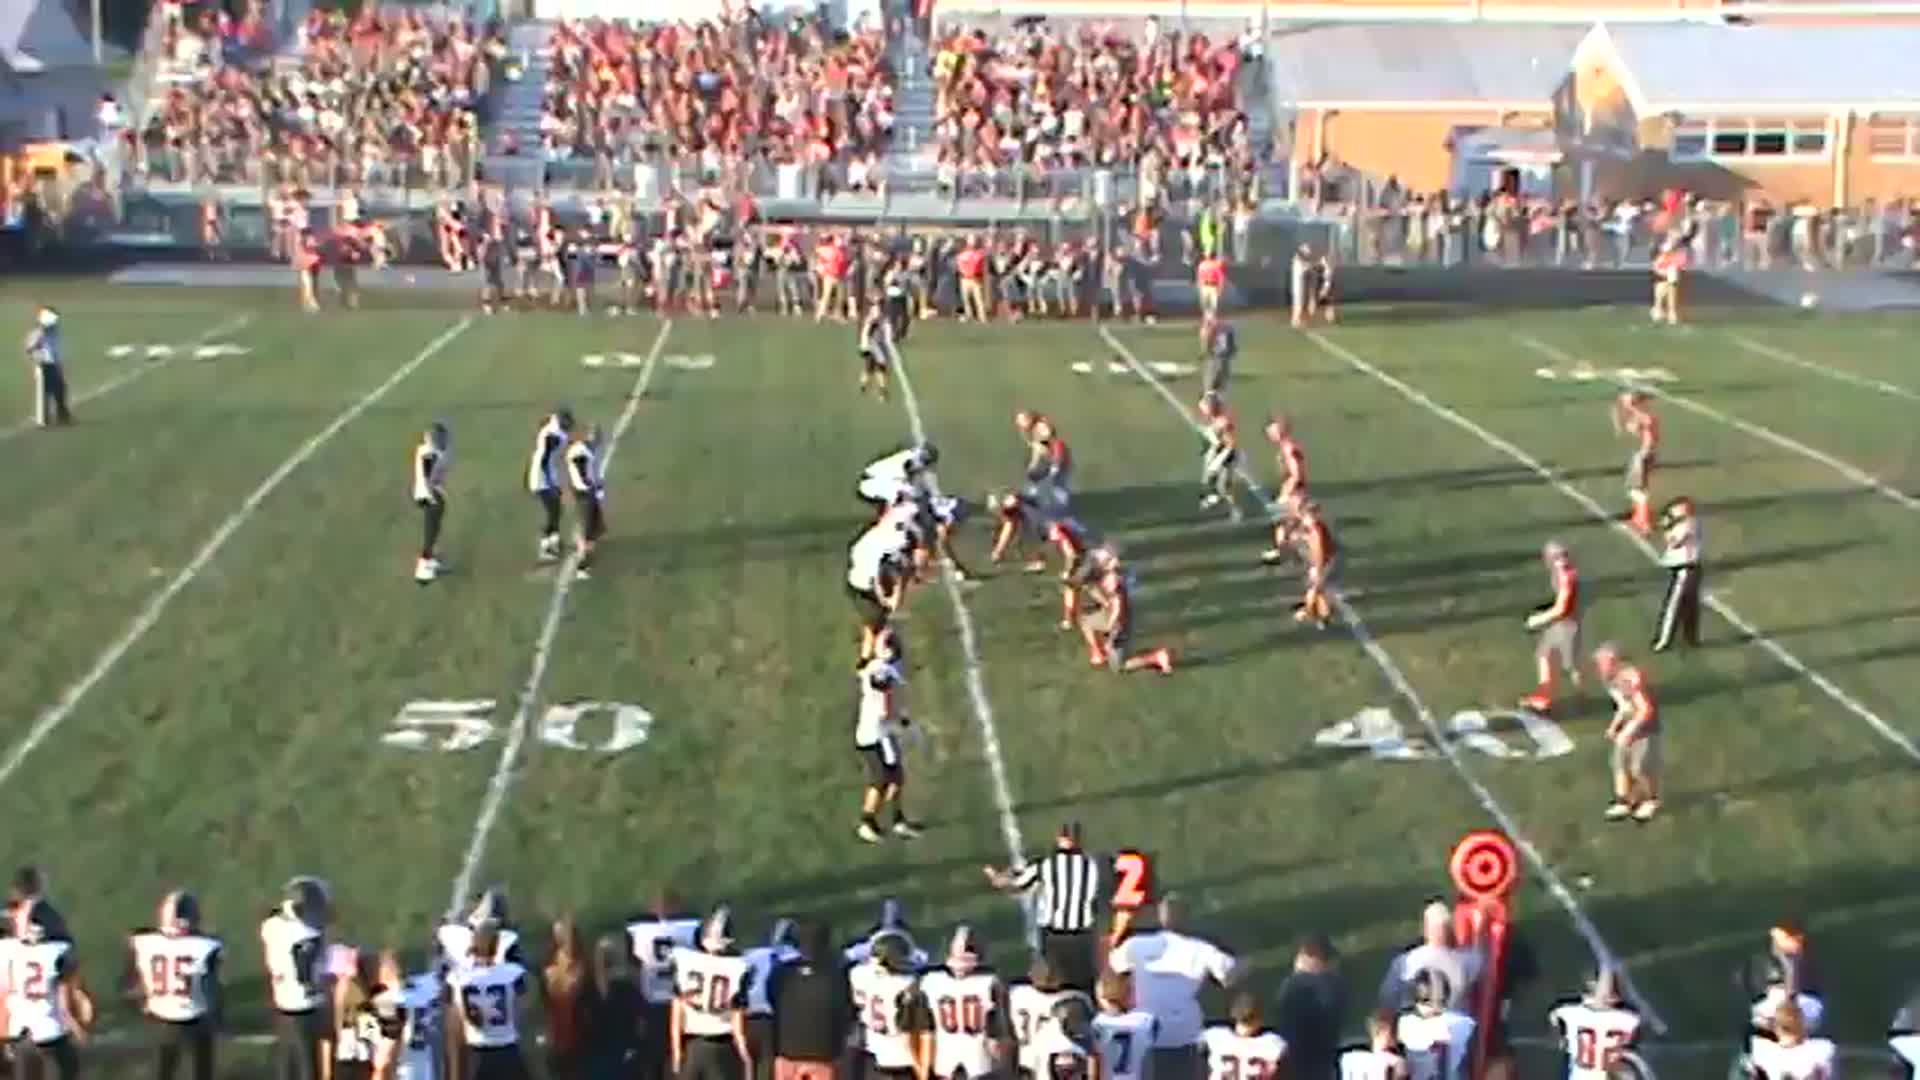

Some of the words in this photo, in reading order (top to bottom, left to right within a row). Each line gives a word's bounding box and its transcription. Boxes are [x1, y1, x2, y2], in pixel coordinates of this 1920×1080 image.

[380, 699, 654, 752] 50
[1315, 706, 1576, 760] 40
[1114, 853, 1146, 905] 2
[684, 970, 732, 1014] 20
